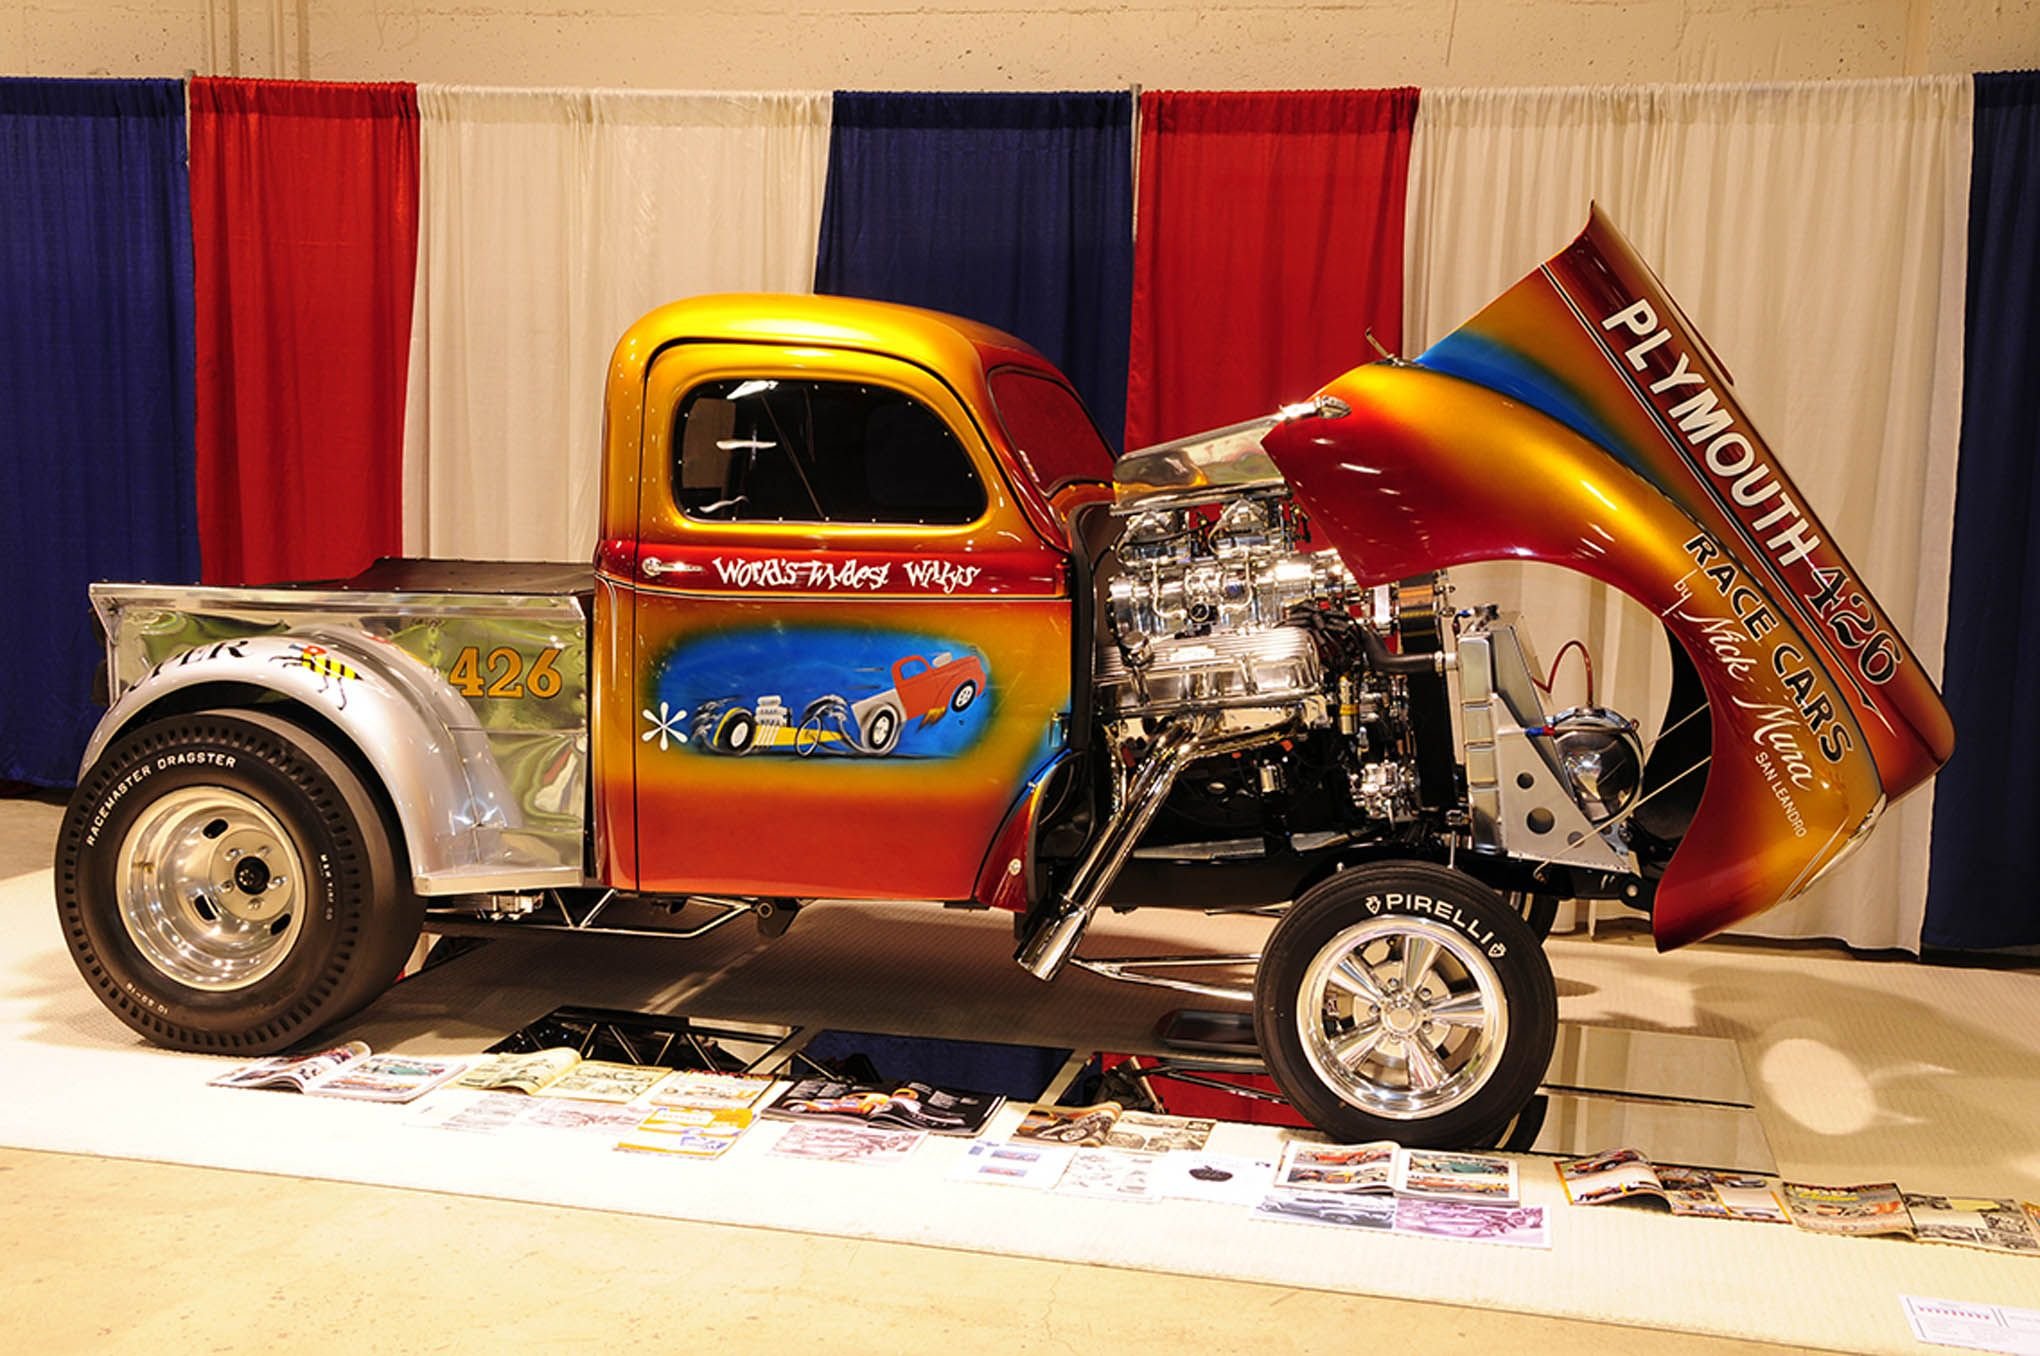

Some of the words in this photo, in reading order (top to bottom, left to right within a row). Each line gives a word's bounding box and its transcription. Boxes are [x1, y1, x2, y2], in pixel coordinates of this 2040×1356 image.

[1602, 298, 1822, 567] PLYMOUTH
[1804, 564, 1903, 685] 426
[1661, 568, 1698, 617] by
[449, 646, 562, 700] 426
[1678, 610, 1758, 683] Nick
[1683, 533, 1780, 642] RACE
[1772, 643, 1854, 764] CARS
[1732, 695, 1815, 792] Mura
[86, 763, 152, 847] RACEMASTER
[156, 751, 237, 769] DRAGSTER
[1755, 751, 1779, 784] SAN
[1772, 781, 1808, 839] LEANDRO
[1385, 893, 1495, 945] PIRELLI
